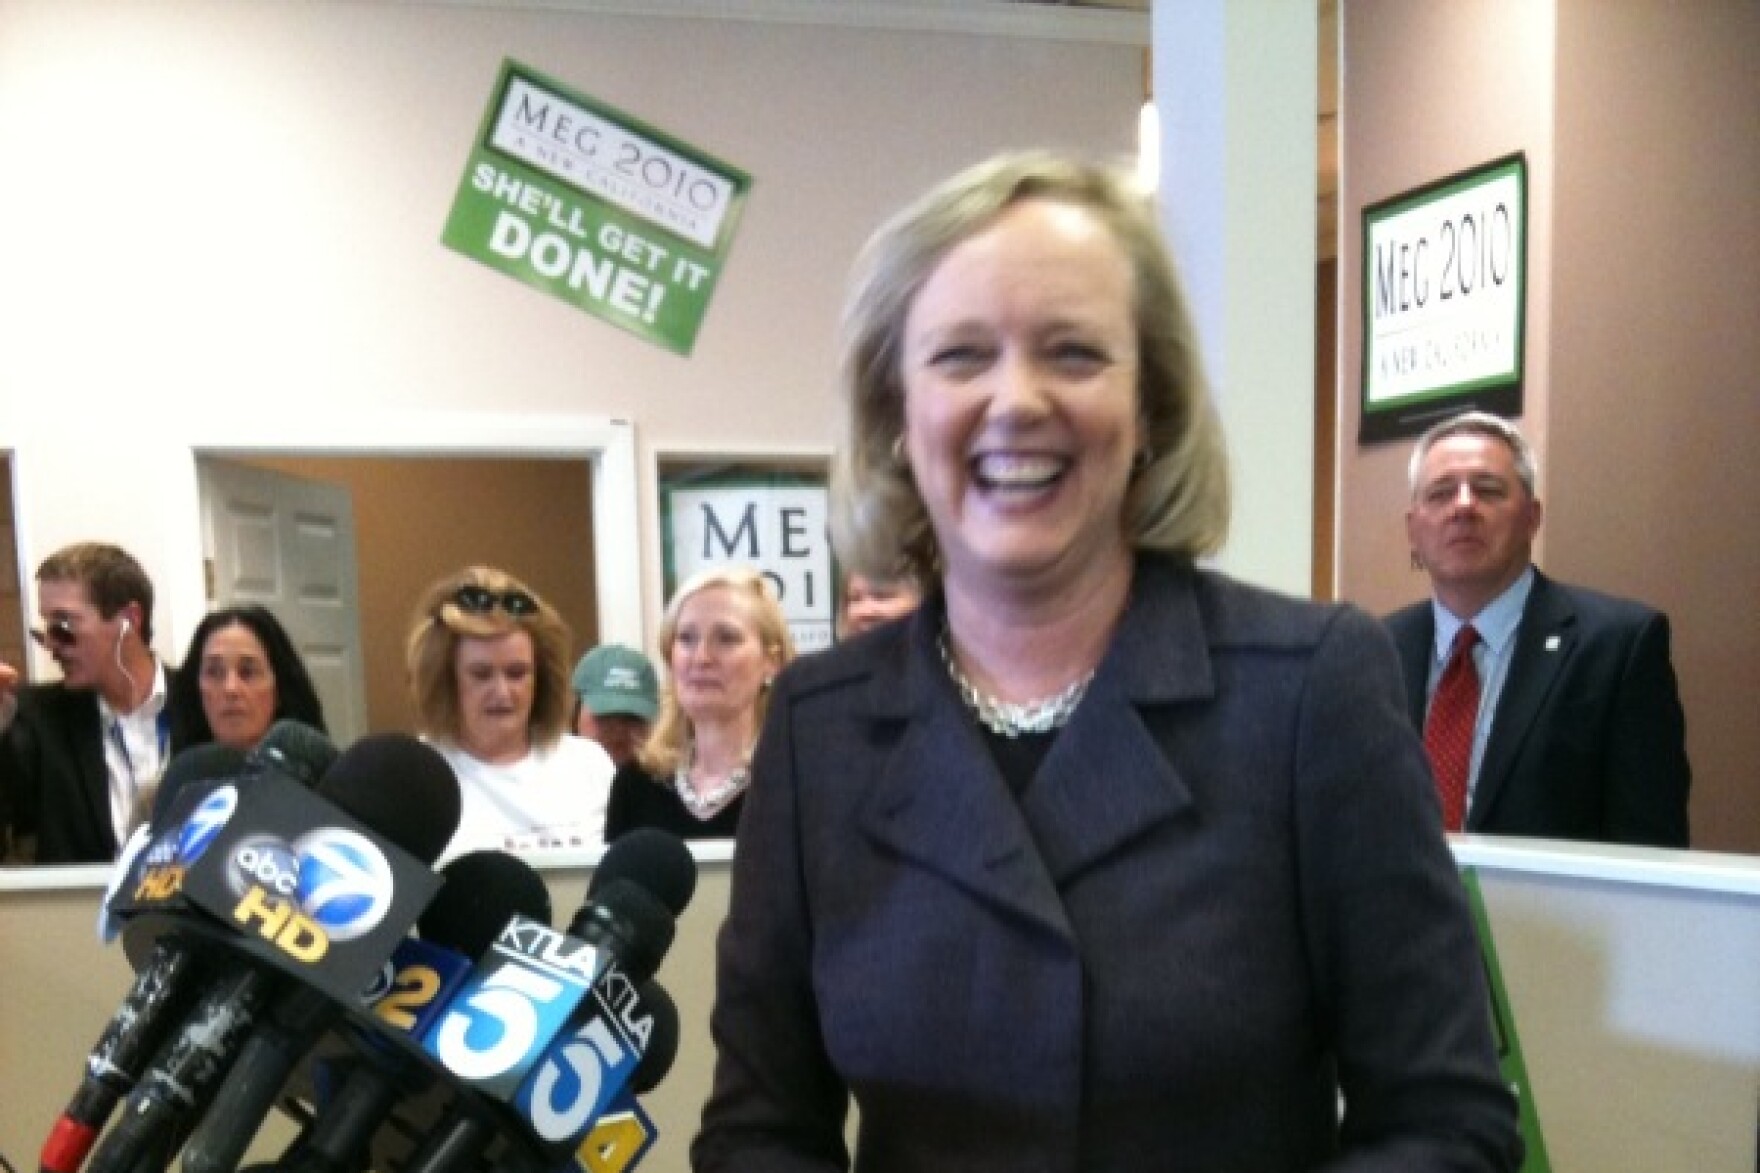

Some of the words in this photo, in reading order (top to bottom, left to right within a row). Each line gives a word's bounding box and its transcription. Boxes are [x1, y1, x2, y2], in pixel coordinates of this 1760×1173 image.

[614, 142, 718, 212] 2010
[472, 163, 588, 239] SHE'LL
[598, 221, 669, 271] GET
[671, 256, 710, 291] IT
[489, 209, 666, 324] DONE!
[1439, 202, 1511, 300] 2010
[699, 500, 828, 559] ME
[236, 847, 298, 894] abc
[233, 885, 330, 963] HD
[498, 914, 598, 980] KTLA
[376, 965, 441, 1031] 2
[437, 963, 565, 1080] 5
[598, 961, 656, 1052] KTLA
[530, 1016, 625, 1142] 5
